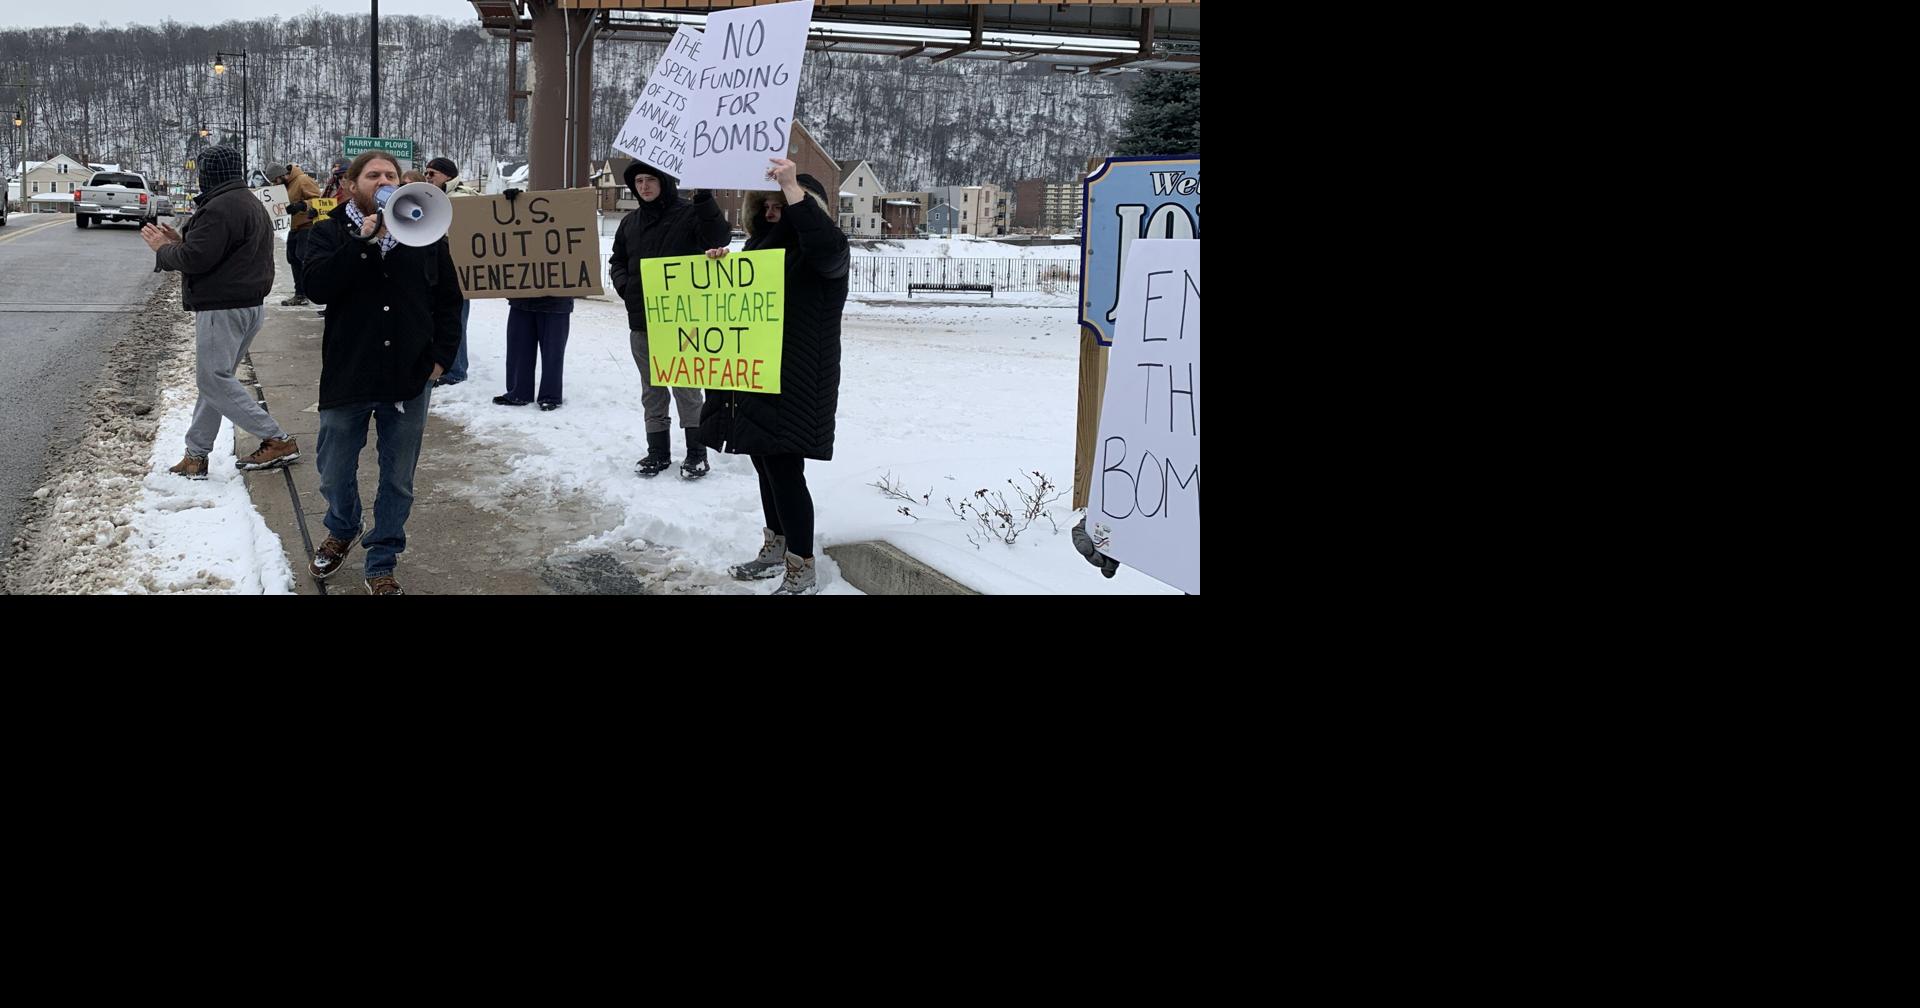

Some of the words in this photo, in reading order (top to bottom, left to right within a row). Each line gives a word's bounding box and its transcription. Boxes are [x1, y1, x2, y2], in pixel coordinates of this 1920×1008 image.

[674, 31, 702, 62] THE
[722, 19, 765, 60] NO
[659, 58, 698, 91] SPEN
[699, 63, 789, 90] FUNDING
[647, 83, 665, 98] OF
[663, 90, 688, 112] ITS
[716, 91, 760, 117] FOR
[636, 100, 681, 135] ANNUAL
[348, 139, 372, 147] HARRY
[384, 141, 408, 149] PLOWS
[619, 131, 647, 156] WAR
[650, 126, 667, 142] ON
[669, 135, 686, 155] TH
[693, 116, 786, 158] BOMBS
[492, 197, 555, 226] U.S.
[471, 230, 533, 258] OUT
[545, 227, 585, 255] OF
[458, 260, 592, 291] VENEZUELA
[663, 257, 755, 291] FUND
[646, 291, 779, 323] HEALTHCARE
[677, 327, 749, 354] NOT
[652, 355, 764, 389] WARFARE
[1137, 362, 1197, 436] TH
[1101, 436, 1200, 519] BOM
